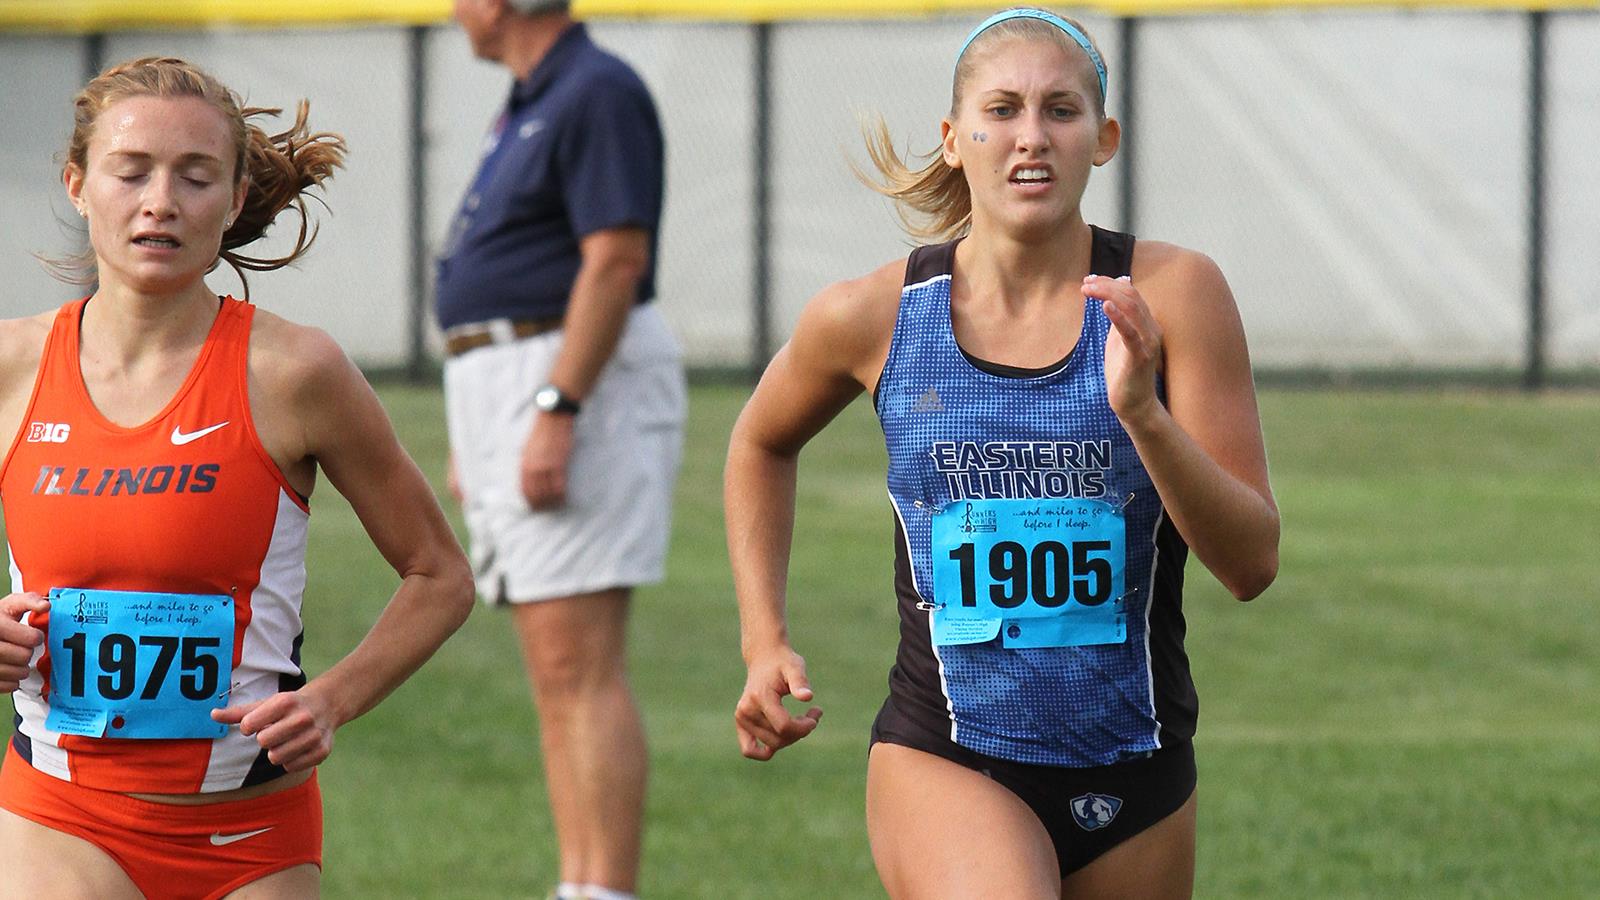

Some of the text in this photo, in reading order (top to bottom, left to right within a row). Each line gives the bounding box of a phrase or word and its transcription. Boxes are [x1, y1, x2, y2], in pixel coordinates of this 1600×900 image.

[930, 440, 1111, 471] EASTERN
[31, 463, 220, 496] ILLINOIS
[947, 471, 1106, 500] ILLINOIS
[1023, 519, 1052, 531] before
[1046, 507, 1073, 516] miles
[1078, 507, 1088, 515] to
[1092, 508, 1102, 518] go
[949, 540, 1112, 608] 1905
[135, 612, 163, 625] before
[157, 601, 185, 611] miles
[190, 603, 199, 611] to
[203, 605, 214, 615] go
[62, 632, 221, 701] 1975
